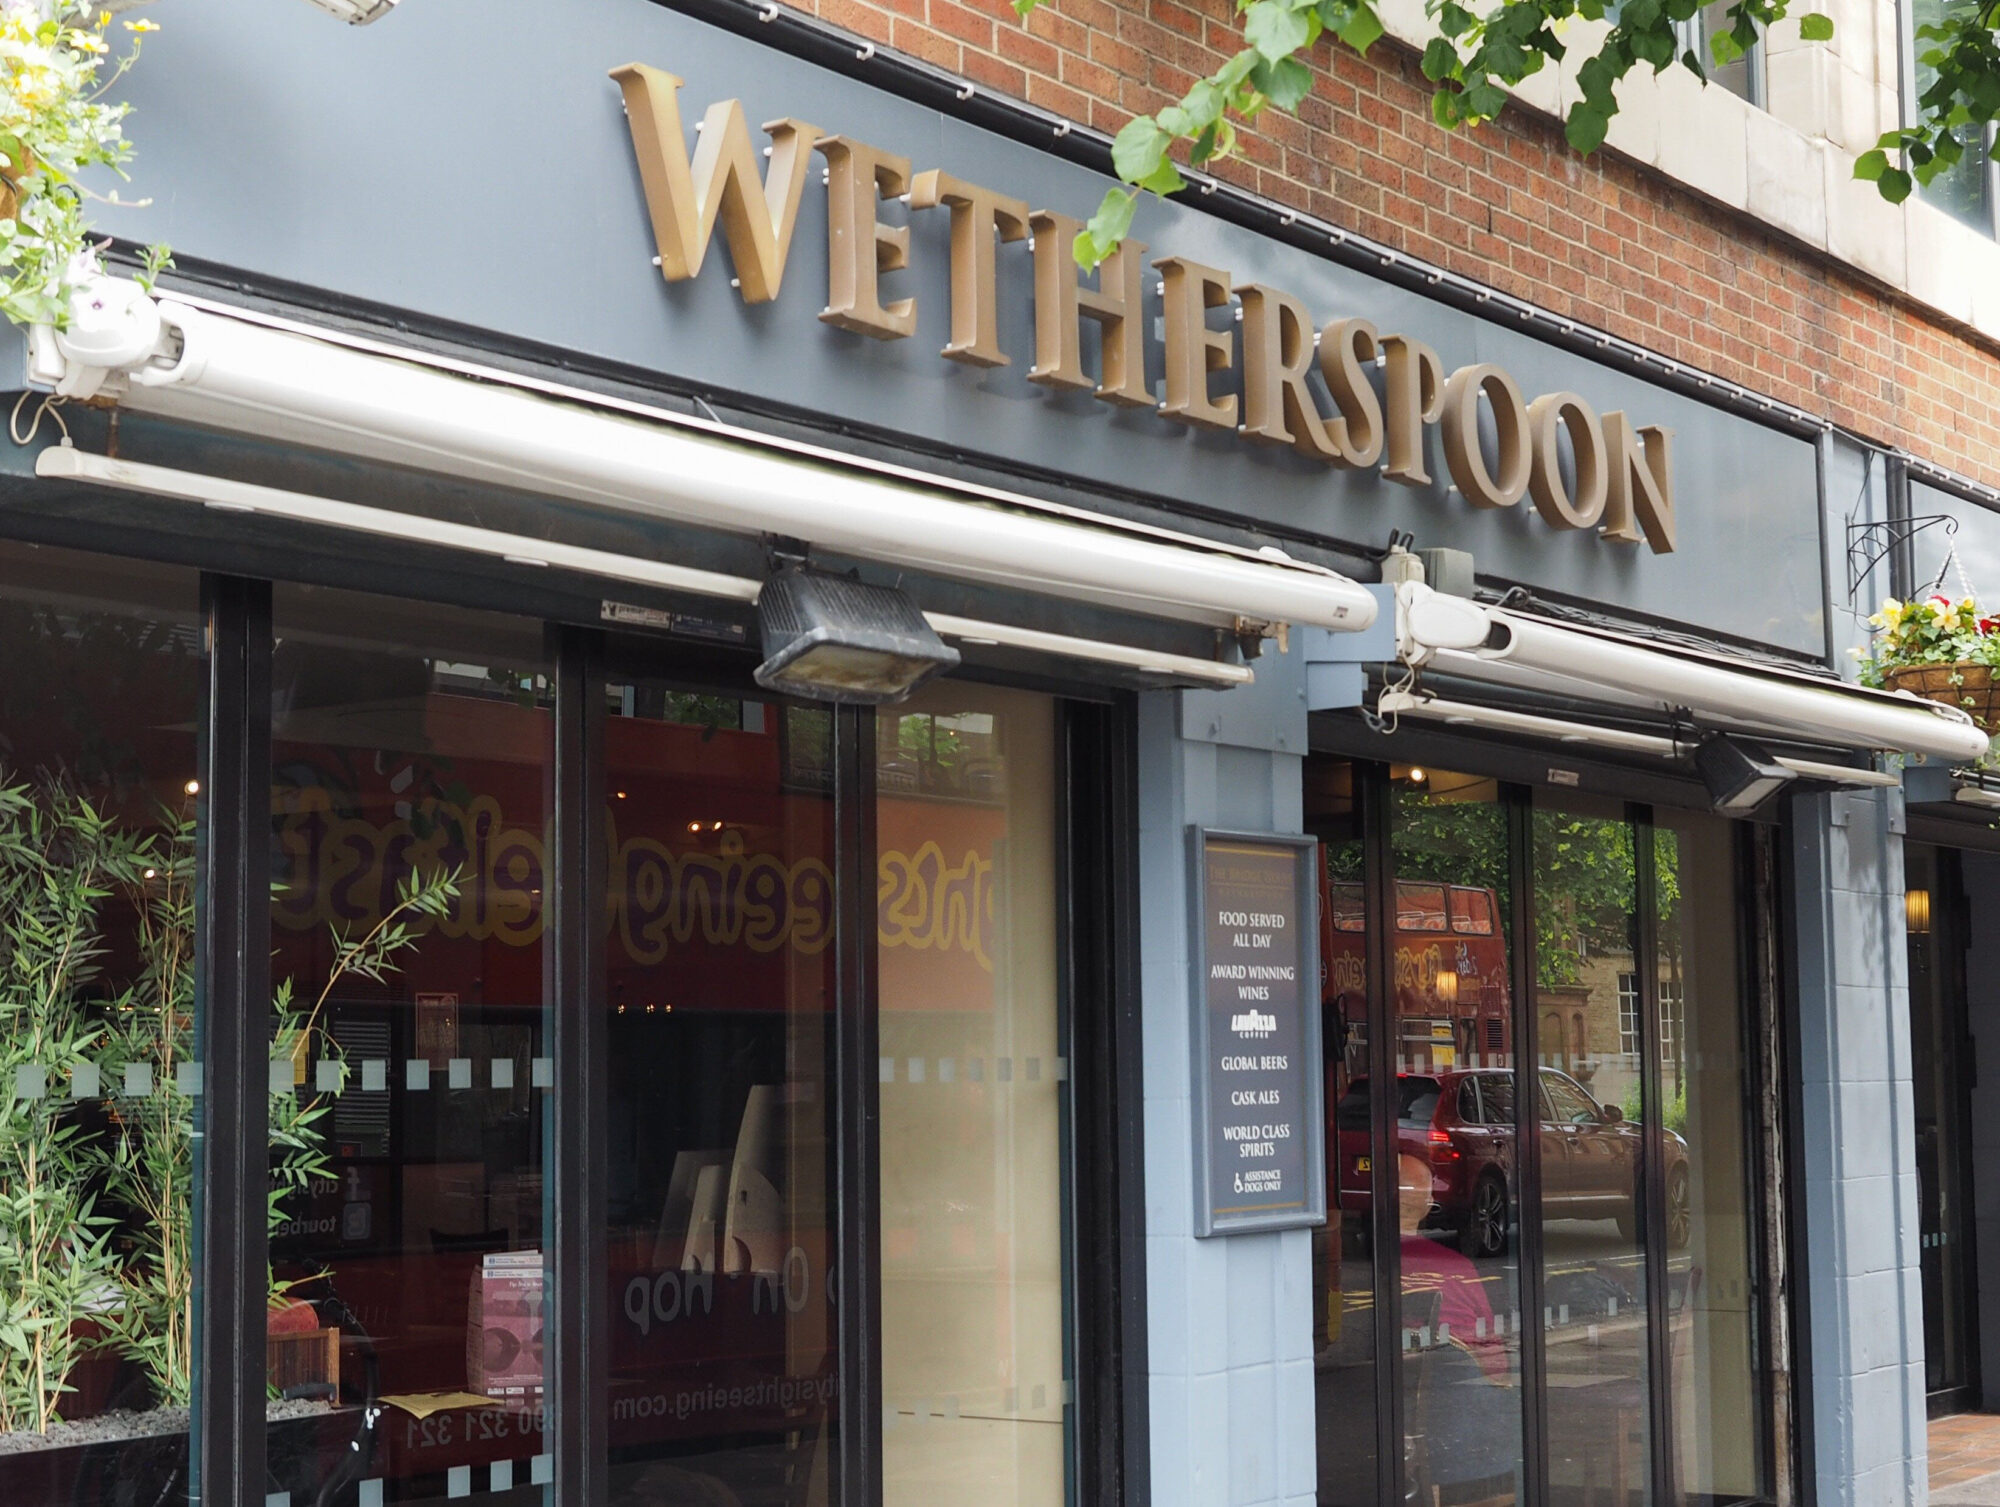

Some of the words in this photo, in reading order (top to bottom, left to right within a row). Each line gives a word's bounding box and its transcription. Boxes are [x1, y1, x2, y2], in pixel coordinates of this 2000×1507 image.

[606, 62, 1677, 555] WETHERSPOON
[1219, 911, 1248, 926] FOOD
[1249, 913, 1285, 929] SERVED
[1233, 933, 1251, 948] ALL
[1252, 934, 1272, 948] DAY
[1211, 965, 1247, 979] AWARD
[1247, 966, 1295, 981] WINNING
[1238, 986, 1270, 1000] WINES
[1221, 1056, 1259, 1071] GLOBAL
[1260, 1056, 1289, 1070] BEERS
[1231, 1091, 1257, 1106] CASK
[1258, 1090, 1280, 1104] ALES
[1223, 1125, 1261, 1141] WORLD
[1261, 1124, 1291, 1139] CLASS
[1239, 1142, 1275, 1158] SPIRITS
[1244, 1169, 1281, 1182] ASSISTANCE
[1244, 1181, 1264, 1193] DOGS
[1263, 1180, 1282, 1192] ONLY
